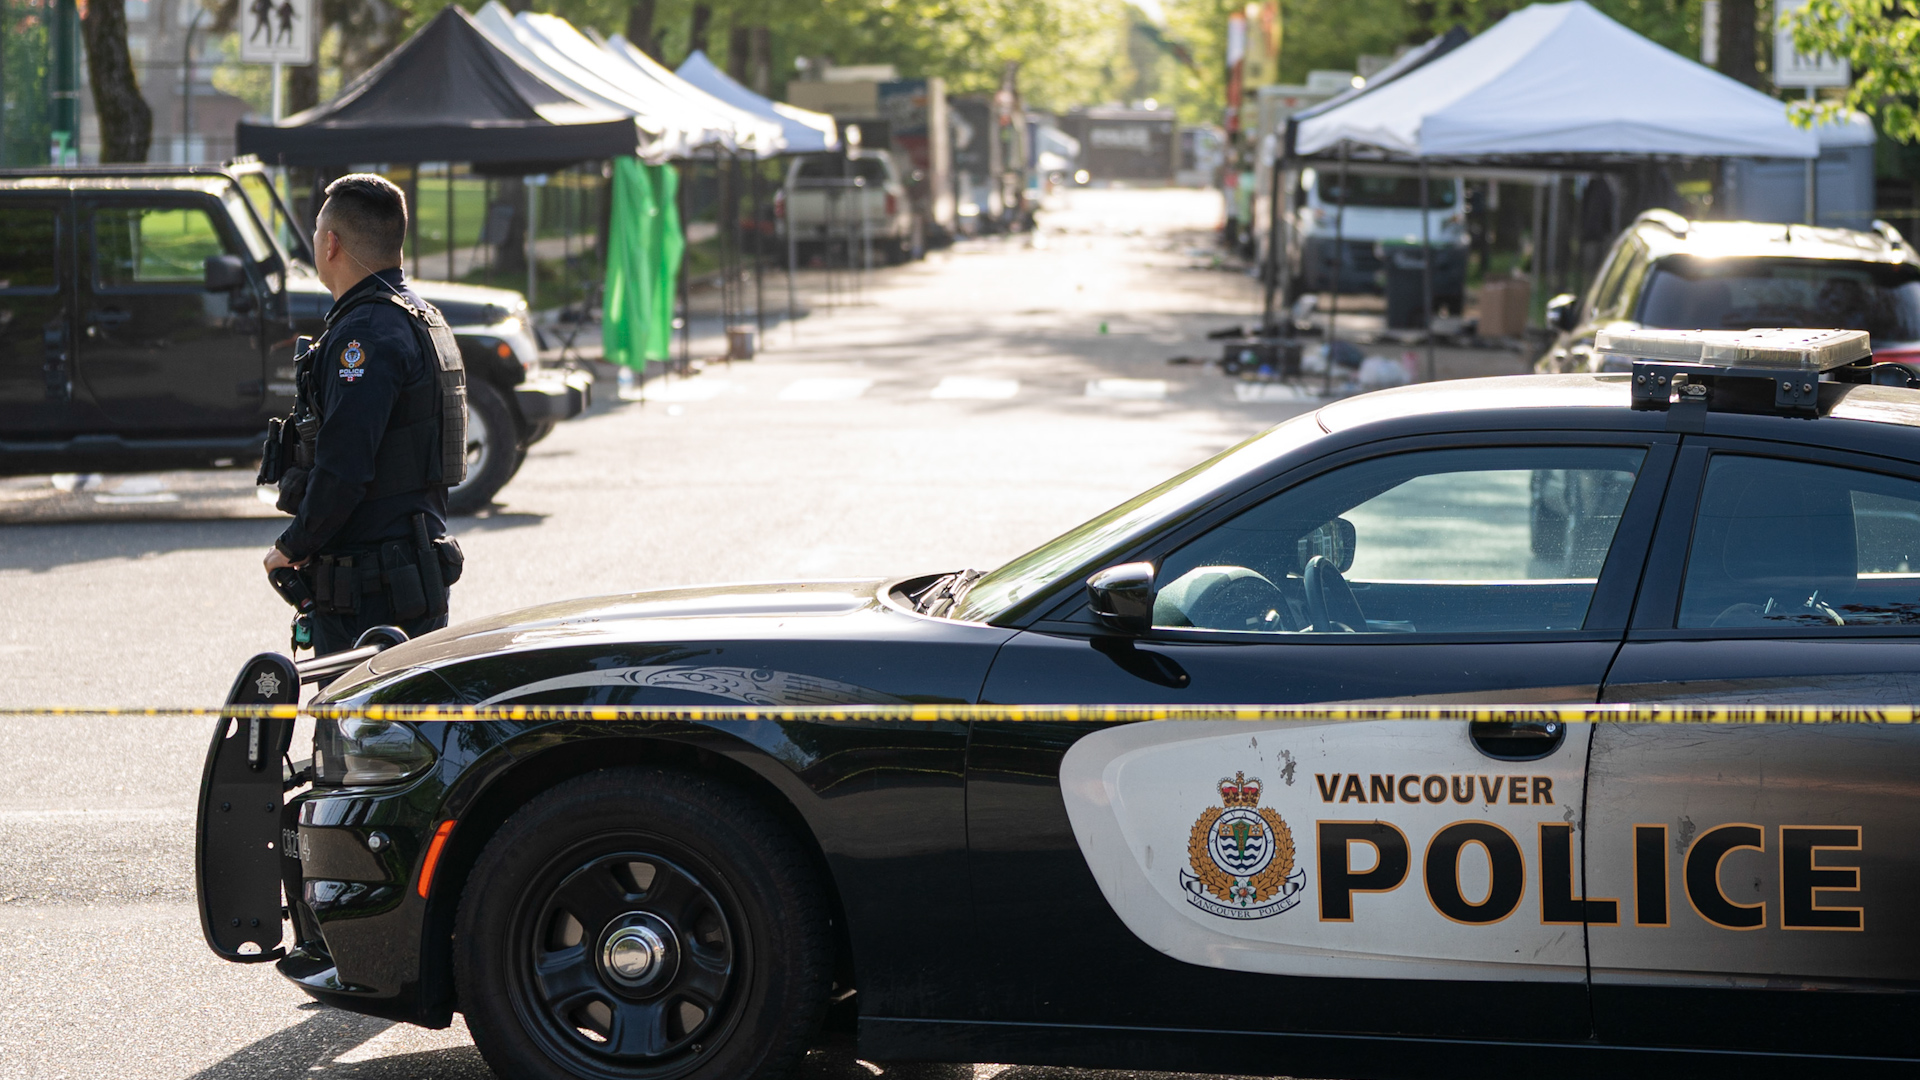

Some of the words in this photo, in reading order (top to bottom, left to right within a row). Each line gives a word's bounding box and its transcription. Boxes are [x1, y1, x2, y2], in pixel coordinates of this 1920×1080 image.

[1315, 773, 1555, 805] VANCOUVER
[1316, 819, 1864, 931] POLICE
[1192, 895, 1251, 918] VANCOUVER
[1258, 898, 1294, 917] POLICE
